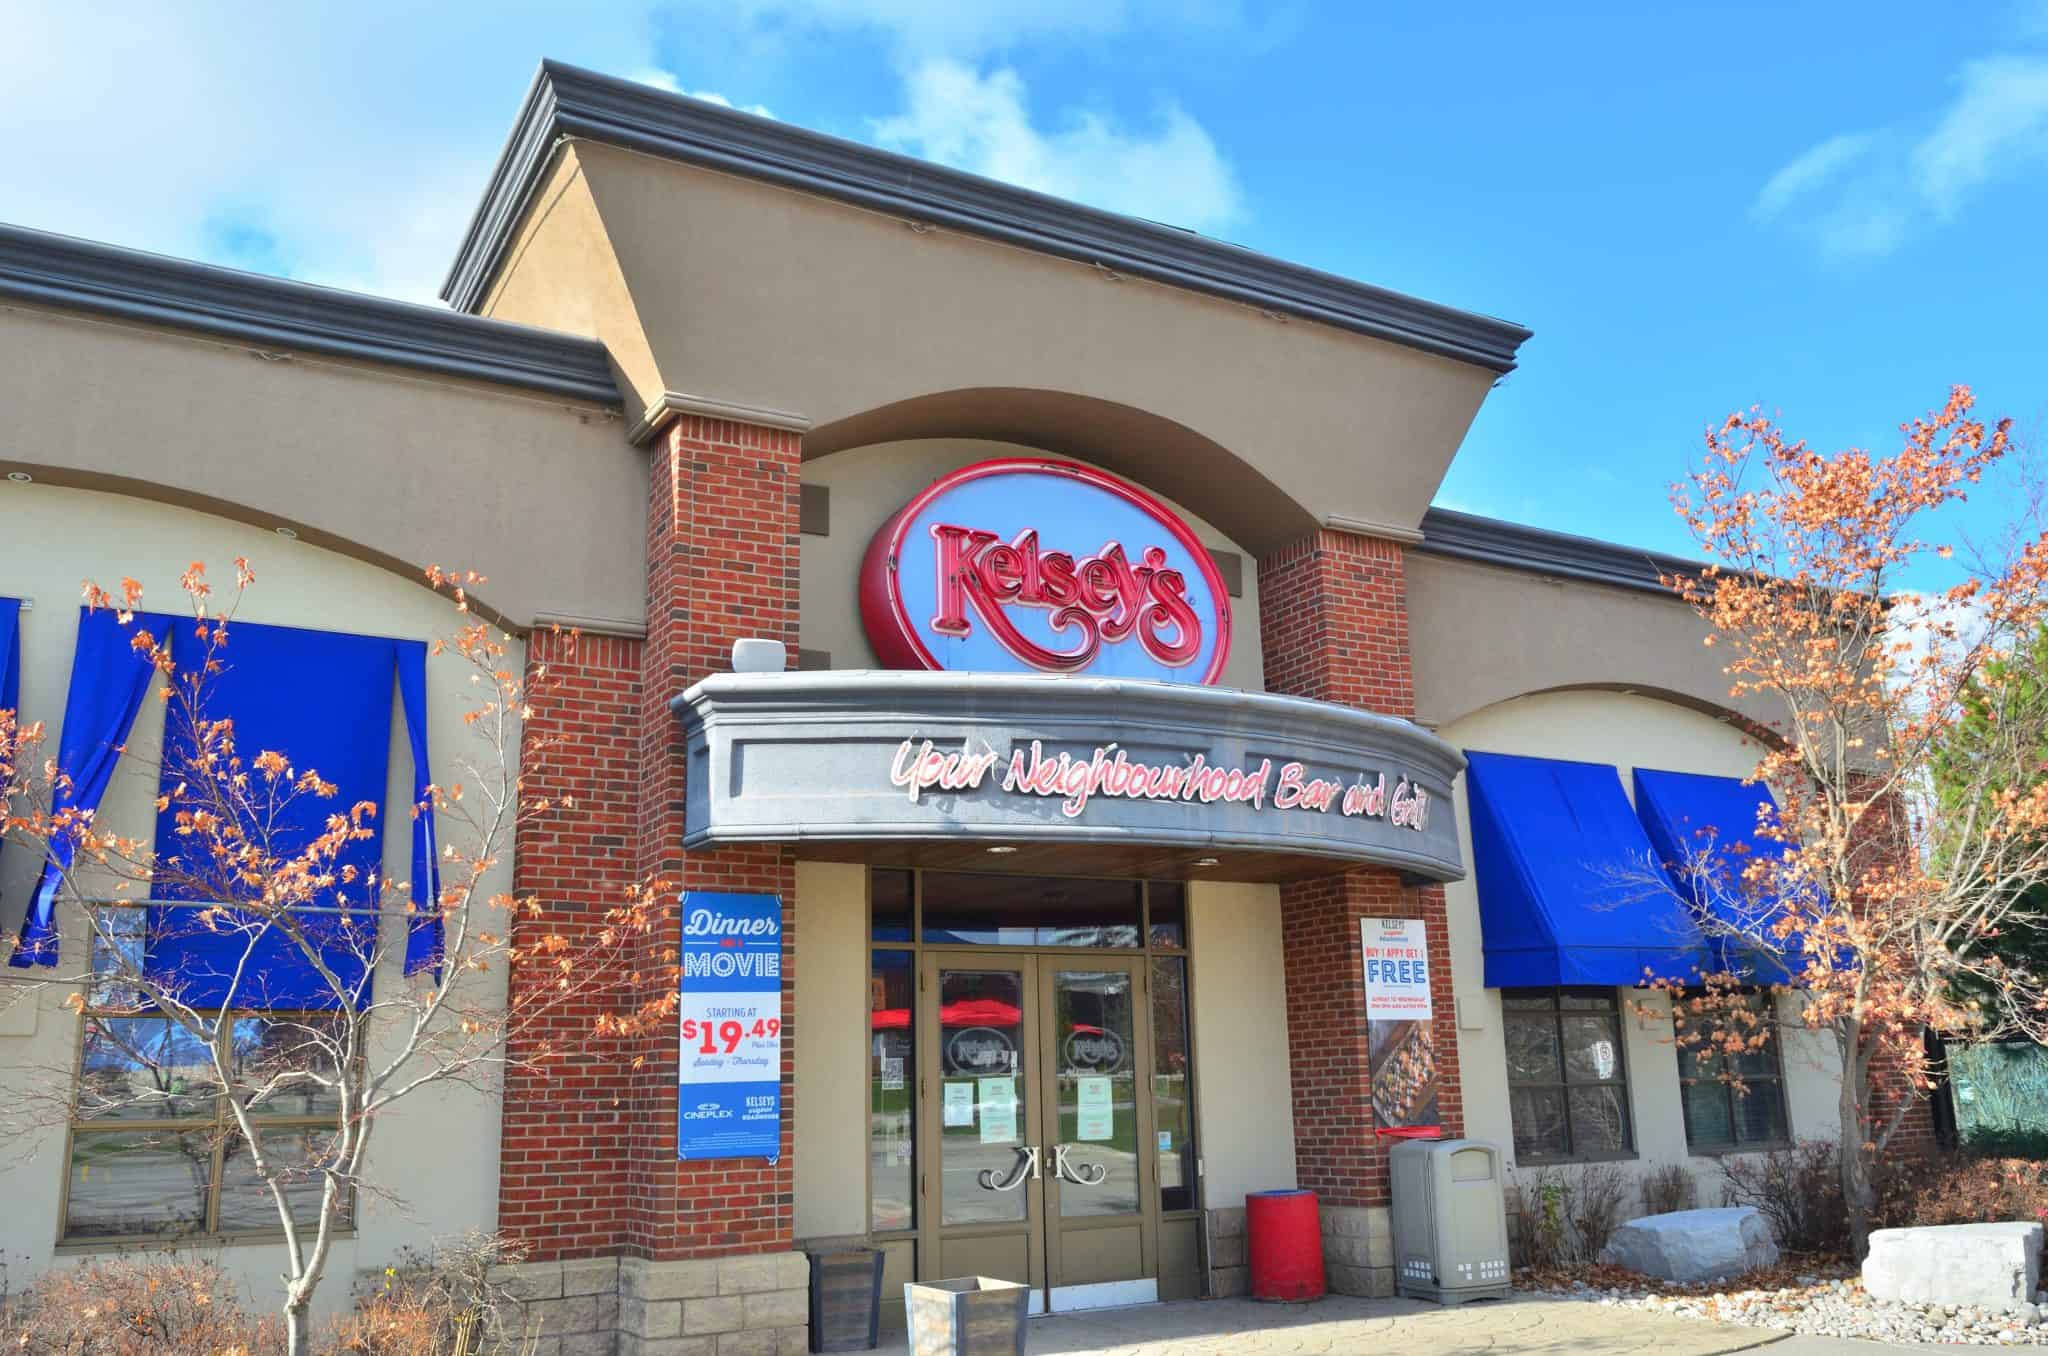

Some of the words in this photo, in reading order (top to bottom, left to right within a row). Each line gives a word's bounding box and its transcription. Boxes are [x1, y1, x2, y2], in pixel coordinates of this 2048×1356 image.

[930, 523, 1202, 673] Kelsey's
[890, 739, 998, 802] Your
[1002, 739, 1272, 818] Neighbourhood
[1274, 761, 1341, 813] Bar
[1342, 772, 1385, 817] and
[684, 908, 779, 936] Dinner
[684, 952, 779, 977] MOVIE
[1367, 960, 1426, 984] FREE
[706, 1007, 746, 1018] STARTING
[747, 1007, 758, 1017] AT
[682, 1018, 780, 1055] $19.49
[745, 1095, 776, 1107] KELSEYS
[683, 1109, 733, 1120] CINEPLEX
